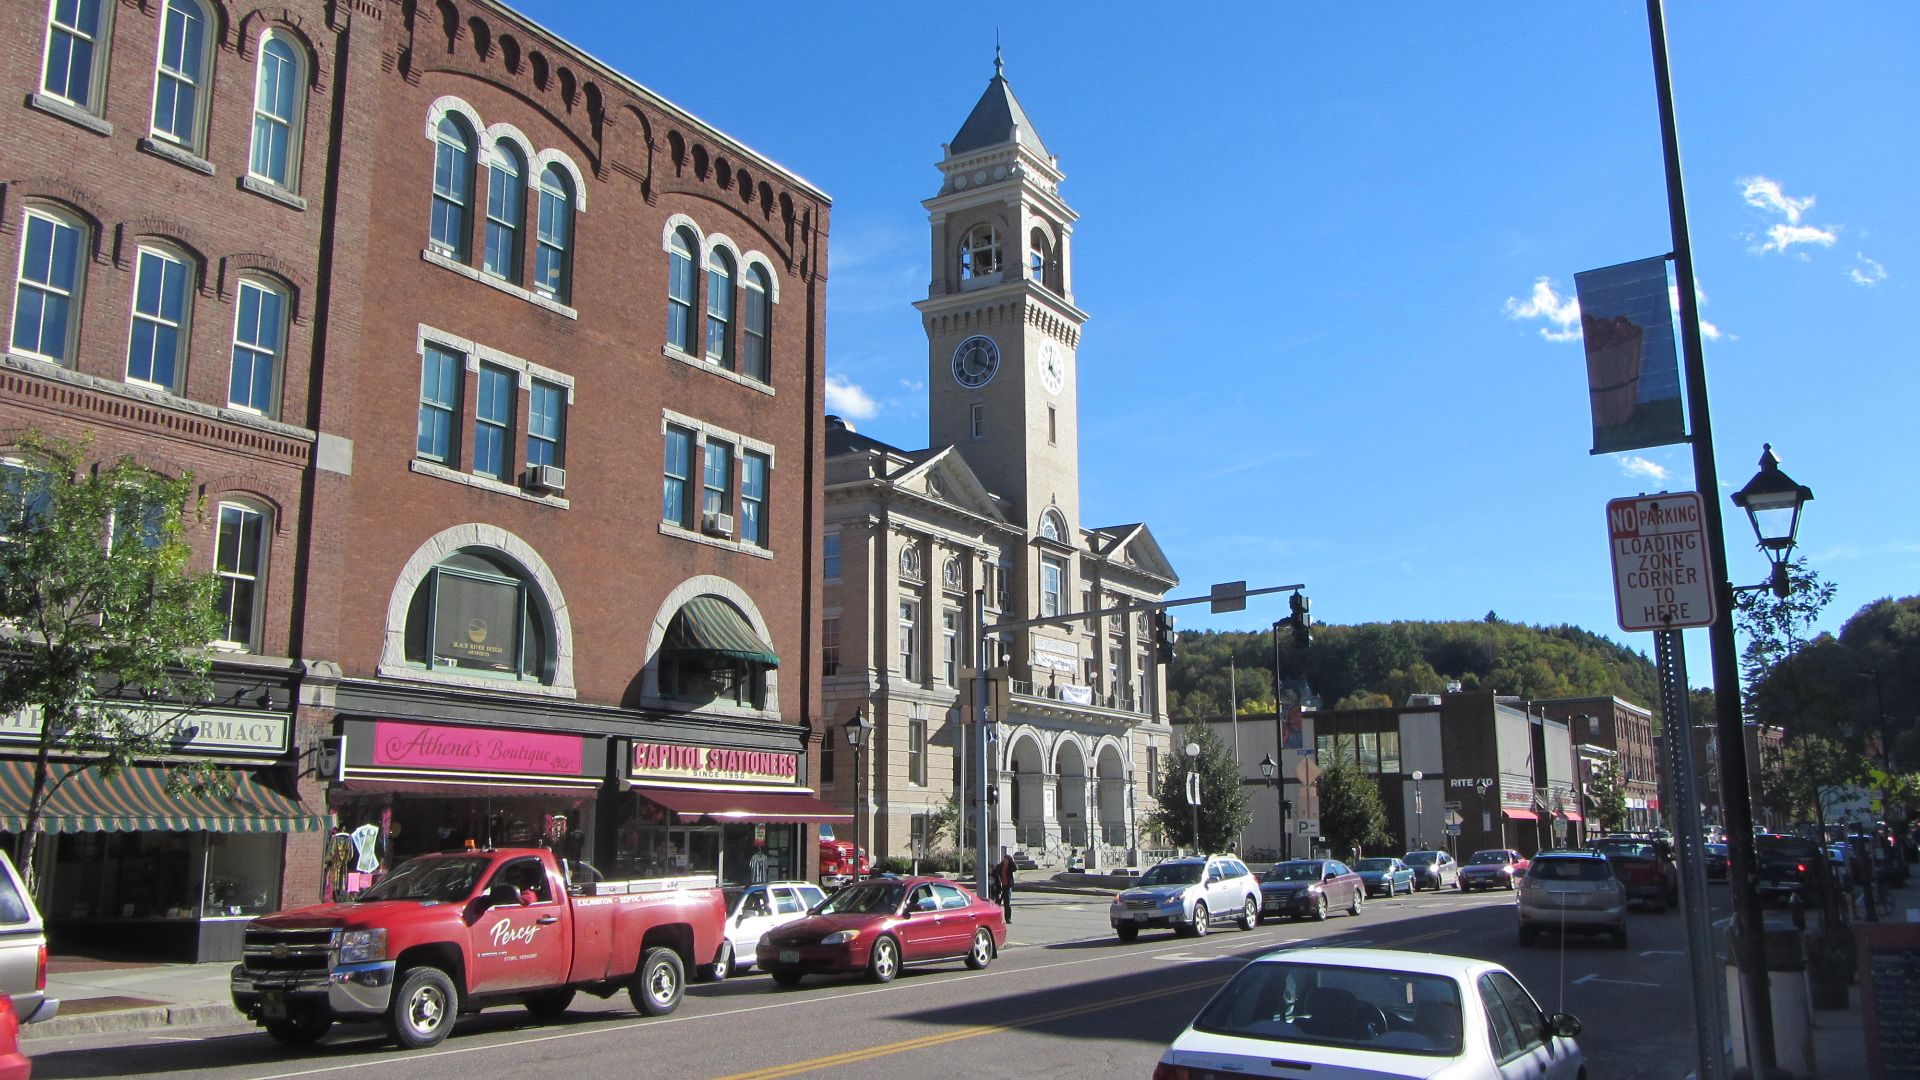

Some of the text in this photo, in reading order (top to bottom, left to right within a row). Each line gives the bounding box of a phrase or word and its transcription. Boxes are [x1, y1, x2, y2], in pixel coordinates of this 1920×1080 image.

[1610, 505, 1697, 532] NO PARKING
[1621, 534, 1696, 555] LOADING
[1639, 551, 1685, 571] ZONE
[1627, 567, 1698, 589] CORNER
[1653, 587, 1675, 604] TO
[1644, 602, 1690, 622] HERE
[386, 727, 549, 767] Athena's Boutique
[634, 743, 798, 778] CAPITOL STATIONERS
[693, 770, 719, 778] SINCE
[1450, 778, 1474, 787] RITE
[490, 917, 540, 947] Percy
